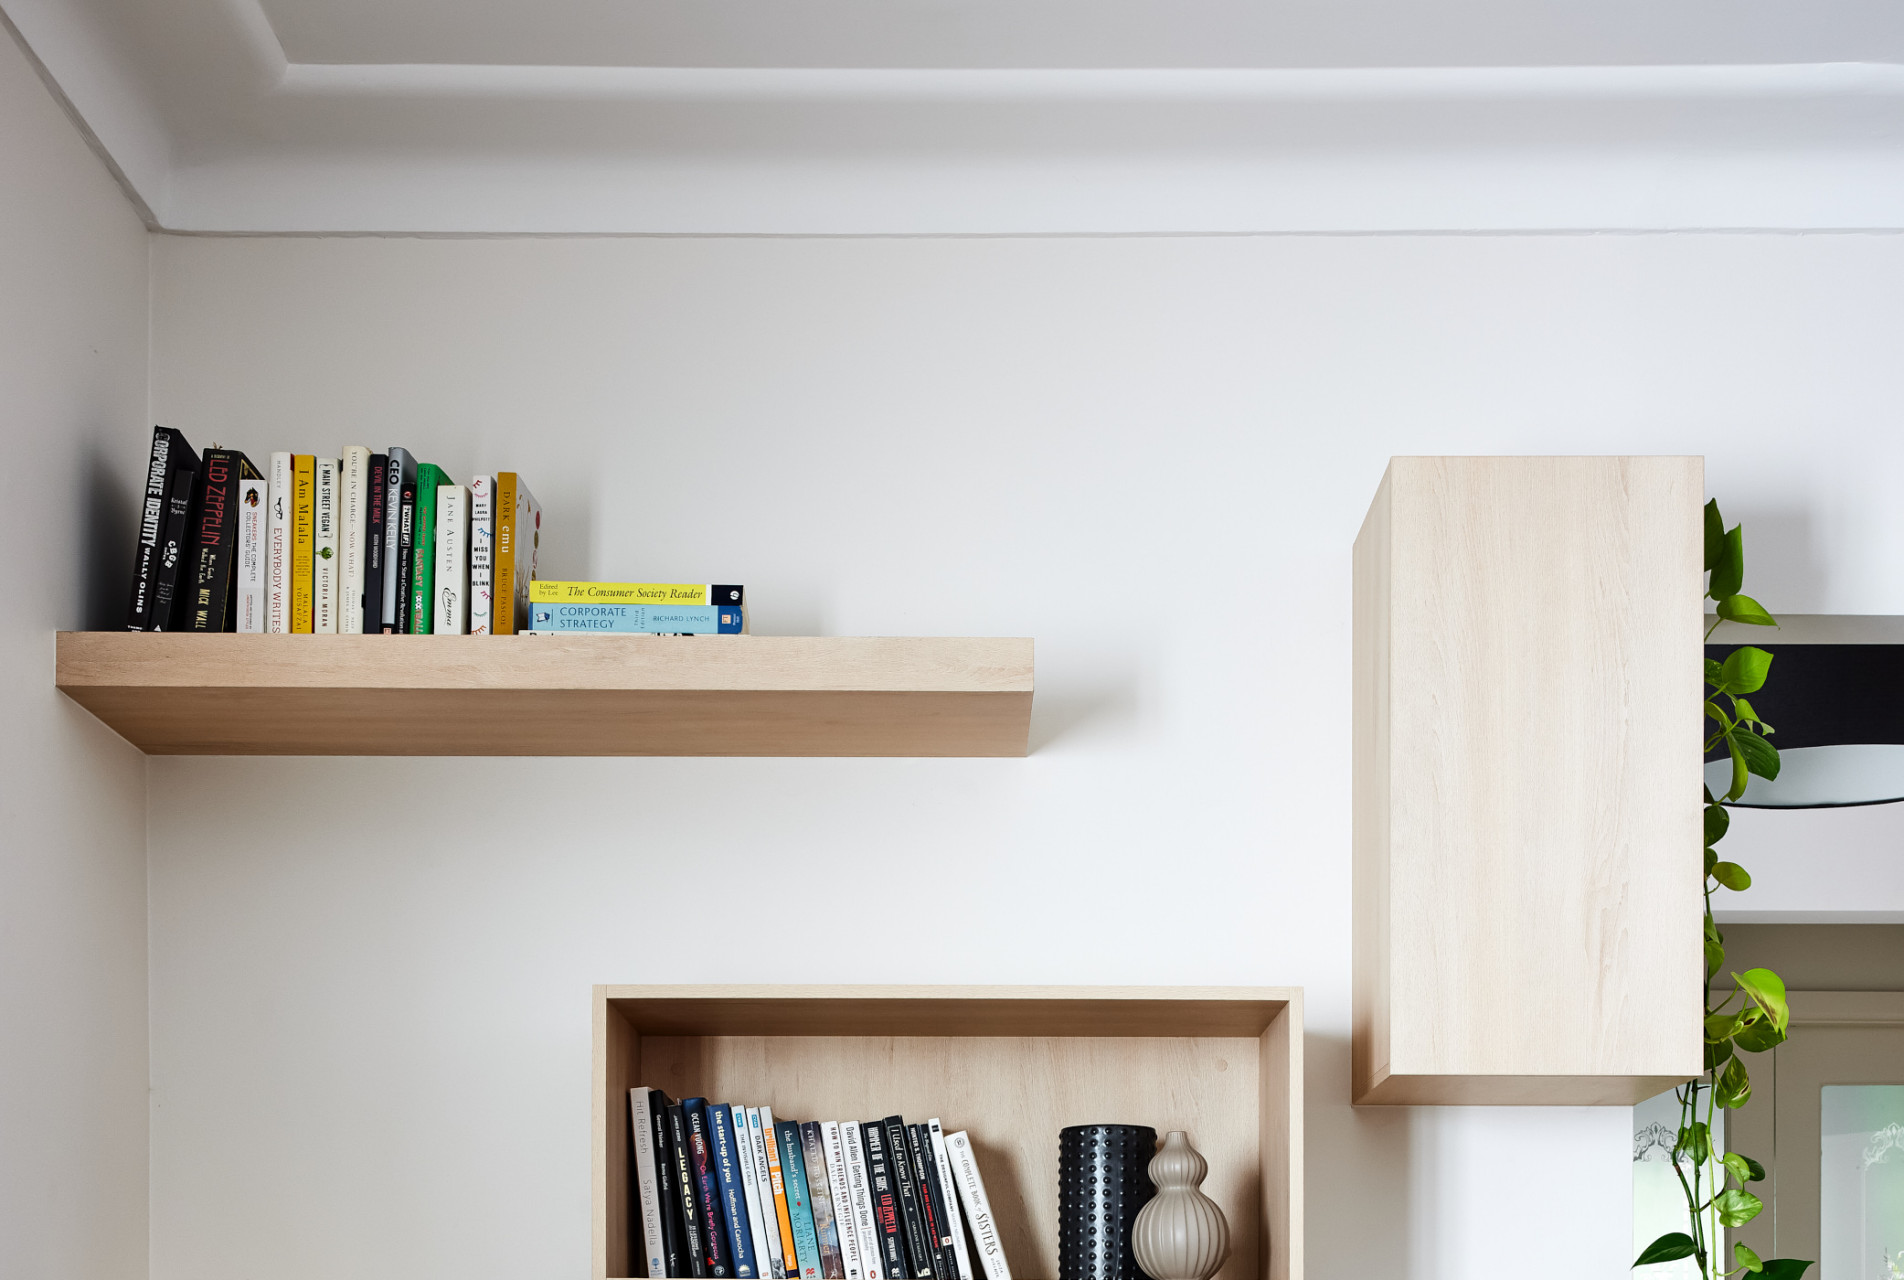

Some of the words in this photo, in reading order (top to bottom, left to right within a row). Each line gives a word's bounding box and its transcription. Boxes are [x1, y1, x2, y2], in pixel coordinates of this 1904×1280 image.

[148, 433, 170, 496] CORPORATE
[208, 459, 229, 482] LED
[374, 466, 383, 484] DEVIL
[389, 460, 400, 485] CEO
[299, 480, 309, 499] Am
[322, 470, 331, 486] MAIN
[351, 481, 357, 490] IN
[322, 488, 330, 510] STREET
[373, 494, 382, 506] THE
[387, 488, 398, 520] KEVIN
[446, 496, 455, 522] JANE
[502, 492, 511, 521] DARK
[141, 497, 162, 547] IDENTITY
[200, 485, 226, 546] ZEPPELIN
[298, 504, 309, 544] Malala
[321, 512, 330, 532] VEGAN
[372, 508, 381, 524] MILK
[386, 523, 396, 550] KELLY
[501, 525, 511, 553] emu
[164, 540, 178, 568] CBGB
[273, 528, 282, 589] EVERYBODY
[446, 530, 455, 572] AUSTEN
[141, 547, 151, 579] WALLY
[415, 548, 425, 587] FANTASY
[136, 582, 146, 613] OLINS
[198, 588, 211, 605] MICK
[567, 586, 584, 596] The
[588, 586, 635, 598] Consumer
[636, 588, 667, 601] Society
[669, 588, 703, 599] Reader
[271, 591, 281, 634] WRITES
[441, 587, 457, 626] Emma
[560, 607, 627, 616] CORPORATE
[195, 610, 208, 629] WALL
[560, 619, 615, 629] STRATEGY
[636, 1101, 644, 1115] Hit
[715, 1111, 723, 1124] the
[691, 1113, 701, 1133] OCEAN
[637, 1118, 648, 1154] Refresh
[694, 1133, 704, 1154] VUONG
[717, 1125, 728, 1157] start-up
[755, 1136, 763, 1154] DARK
[784, 1130, 792, 1142] the
[846, 1126, 856, 1145] David
[867, 1127, 882, 1152] HAMMER
[892, 1134, 904, 1151] Used
[723, 1158, 732, 1167] of
[742, 1145, 750, 1169] INVISIBLE
[764, 1128, 778, 1162] brilliant
[771, 1171, 784, 1195] Pitch
[786, 1143, 798, 1178] husband's
[849, 1145, 858, 1161] Allen
[872, 1153, 883, 1161] OF
[910, 1127, 919, 1147] HUNTER
[916, 1153, 926, 1180] THOMPSON
[700, 1165, 707, 1175] On
[722, 1168, 732, 1183] you
[758, 1156, 767, 1182] ANGELS
[836, 1164, 846, 1190] FRIENDS
[852, 1165, 862, 1188] Getting
[873, 1163, 885, 1175] THE
[897, 1160, 907, 1180] Know
[961, 1159, 976, 1189] COMPLETE
[643, 1180, 652, 1206] Satya
[678, 1147, 694, 1221] LEGACY
[701, 1176, 709, 1192] Earth
[793, 1179, 801, 1199] secret
[902, 1181, 912, 1197] That
[704, 1192, 712, 1211] We're
[728, 1188, 737, 1216] Hoffman
[841, 1192, 849, 1203] AND
[856, 1188, 866, 1210] Things
[881, 1194, 893, 1205] LED
[971, 1190, 981, 1206] BOOK
[646, 1209, 657, 1246] Nadella
[707, 1211, 716, 1230] Briefly
[732, 1217, 741, 1228] and
[843, 1205, 854, 1239] INFLUENCE
[859, 1210, 868, 1226] Done
[883, 1205, 897, 1233] ZEPPELIN
[710, 1231, 719, 1260] Gorgeous
[735, 1229, 744, 1259] Casnocha
[792, 1213, 808, 1263] MORIARTY
[803, 1221, 816, 1252] LIANE
[975, 1213, 998, 1256] SISTERS
[849, 1239, 858, 1262] PEOPLE
